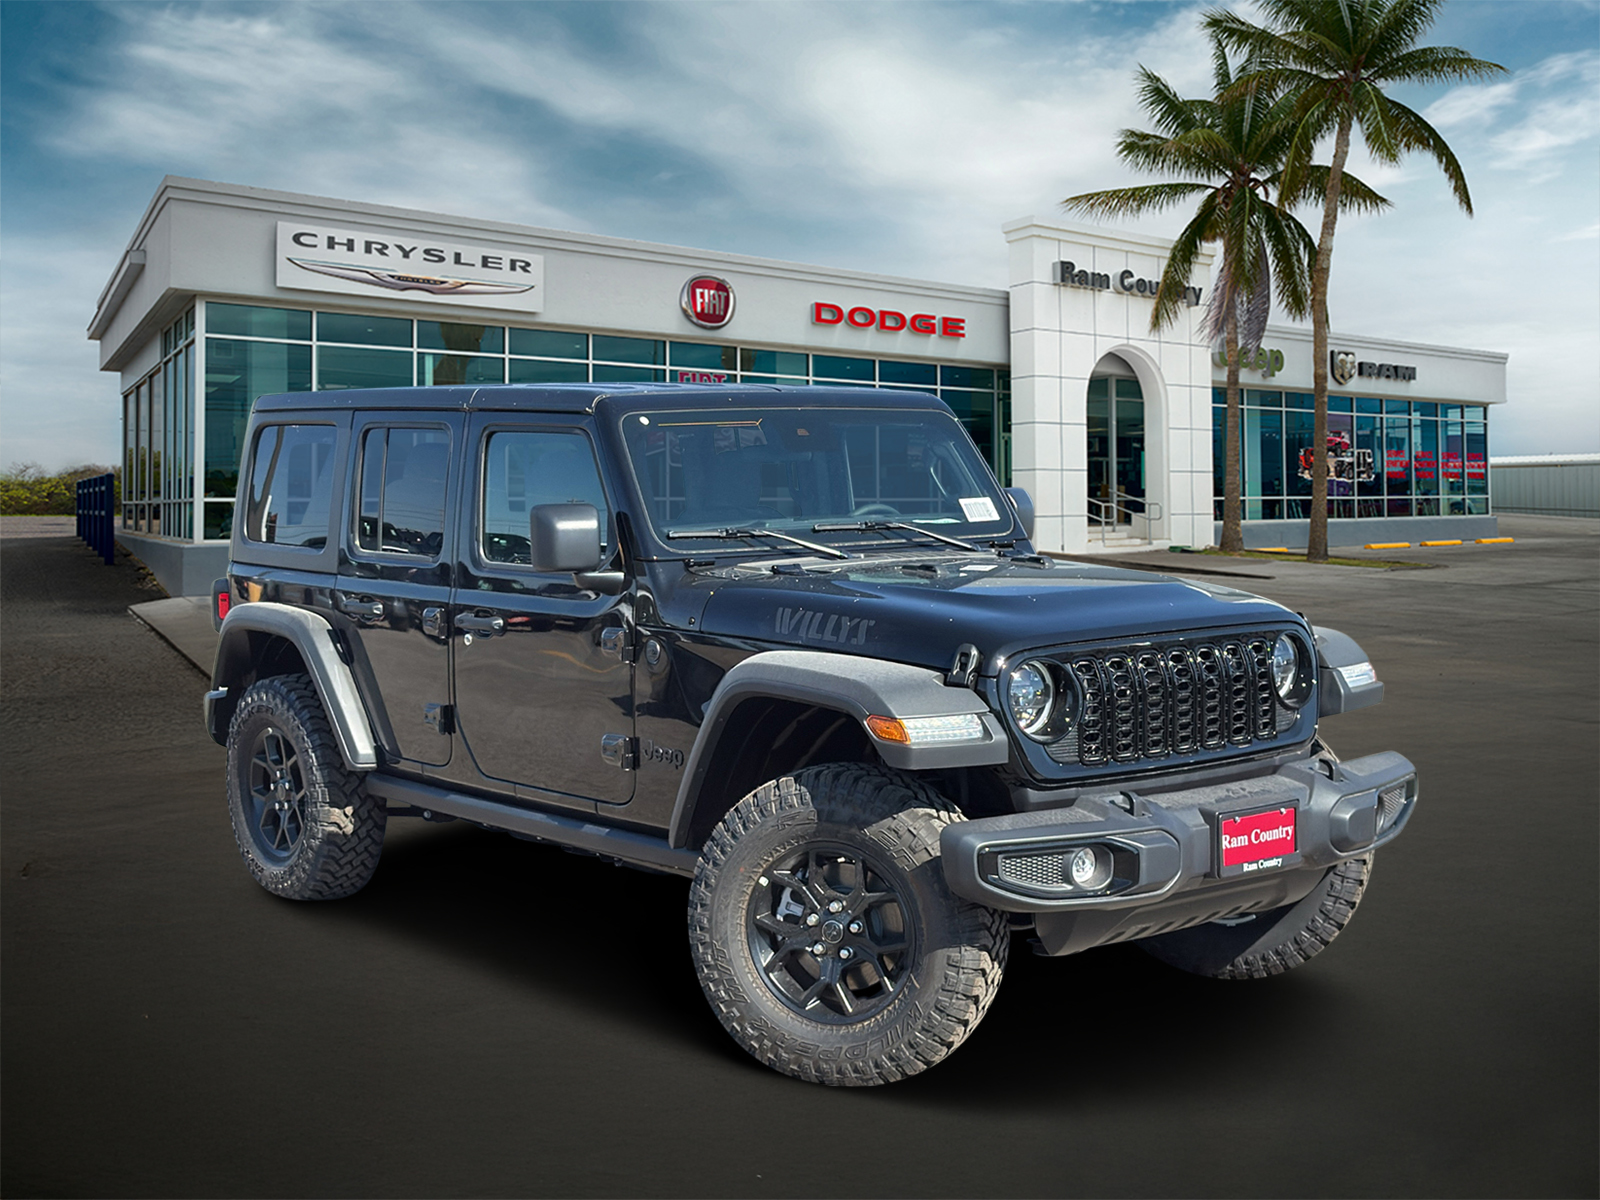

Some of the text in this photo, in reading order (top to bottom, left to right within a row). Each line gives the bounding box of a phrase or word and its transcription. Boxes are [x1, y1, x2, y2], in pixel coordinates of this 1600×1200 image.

[291, 230, 533, 276] CHRYSLER
[1053, 260, 1110, 291] Ram
[695, 277, 728, 316] FIAT
[811, 301, 967, 339] DODGE
[1358, 361, 1417, 382] RAM
[774, 606, 876, 646] WILLYS
[642, 739, 685, 769] Jeep
[1222, 825, 1293, 850] Ram Country
